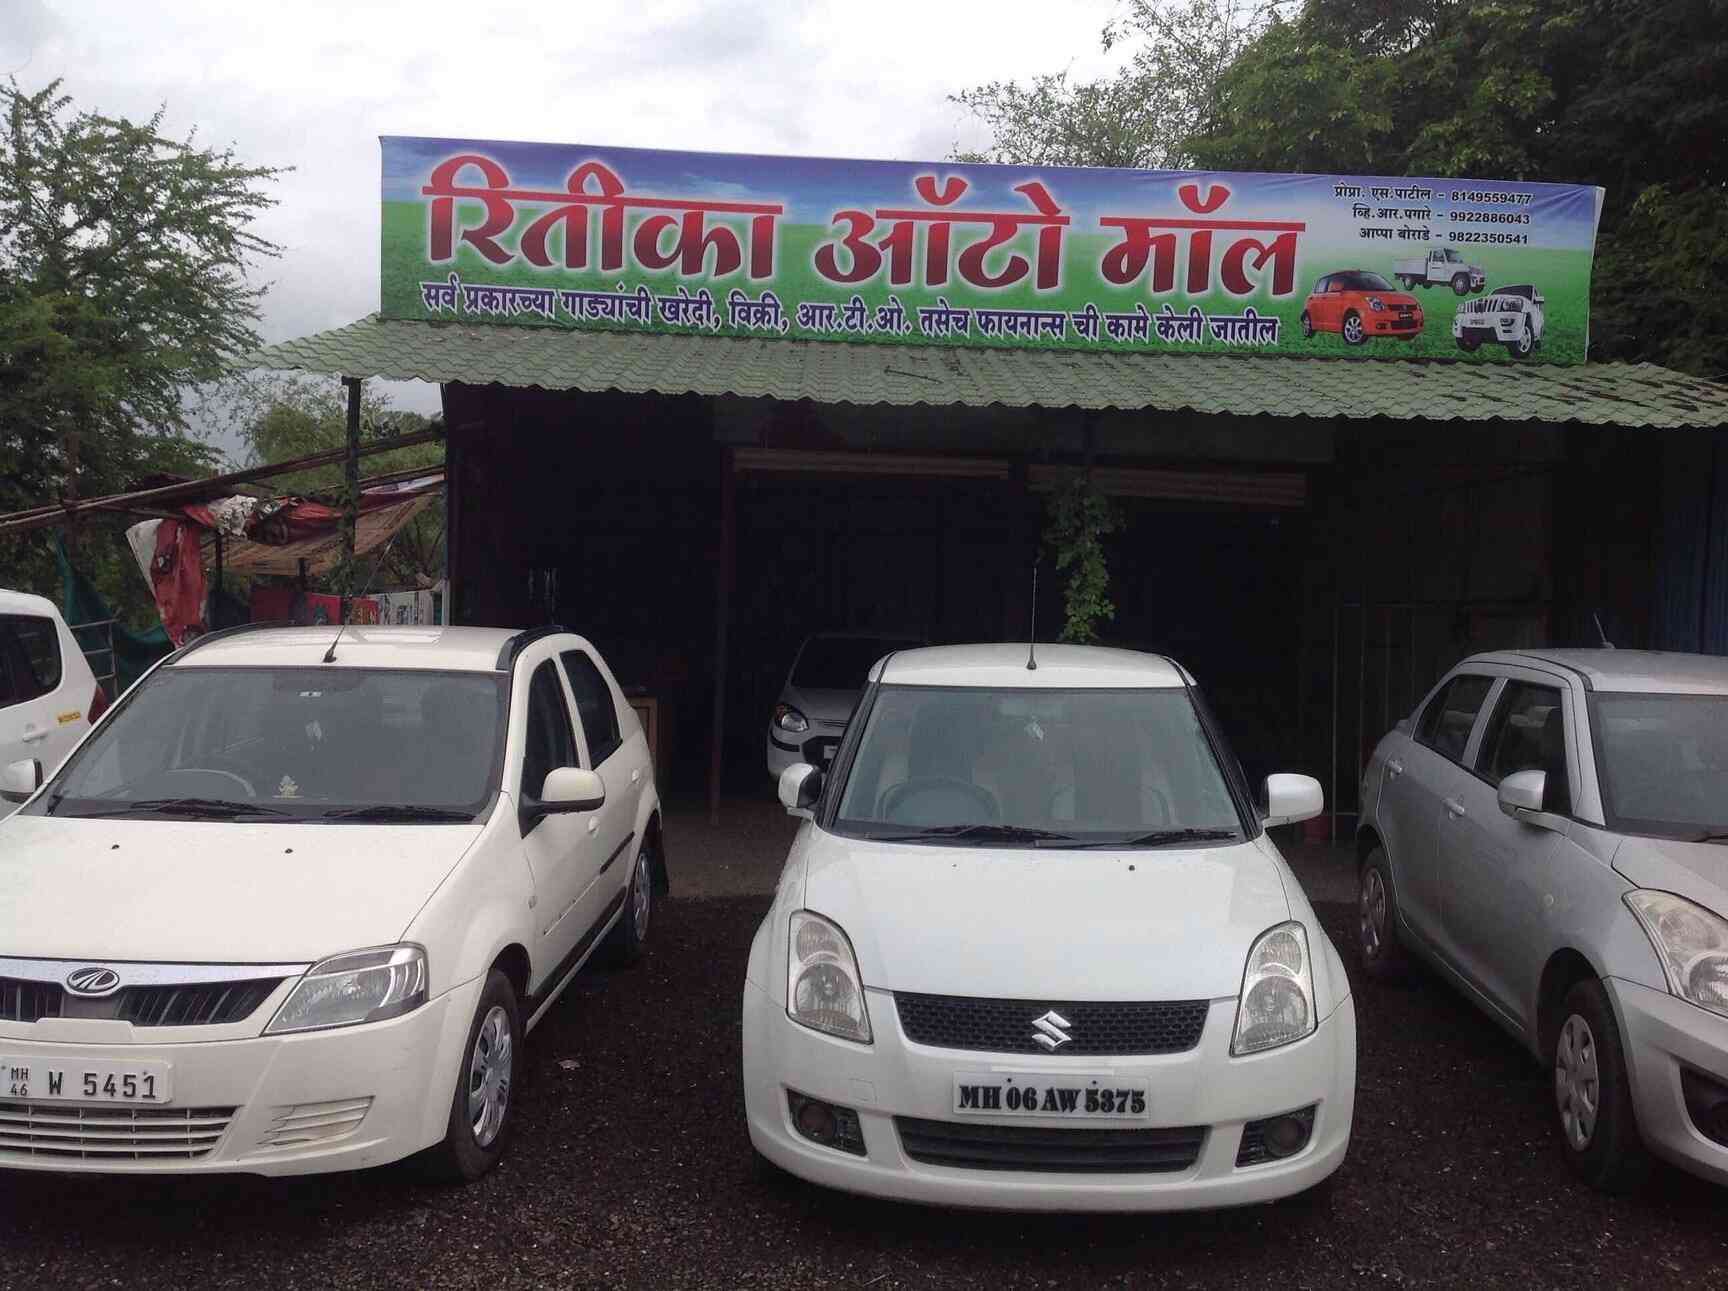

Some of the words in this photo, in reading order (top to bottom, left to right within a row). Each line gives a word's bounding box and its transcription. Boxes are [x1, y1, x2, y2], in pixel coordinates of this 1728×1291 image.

[1451, 191, 1532, 205] 8149559477
[1450, 211, 1530, 225] 9922886043
[422, 154, 784, 280] रितीका
[814, 175, 1071, 291] ऑटो
[1100, 184, 1306, 297] मॉल
[1448, 231, 1528, 245] 9822350541
[421, 273, 460, 313] सर्व
[461, 284, 556, 318] प्रकारच्या
[559, 281, 652, 323] गाड्यांची
[917, 296, 971, 338] तसेच
[975, 308, 1067, 342] फायनान्स
[1070, 302, 1100, 342] ची
[1103, 302, 1150, 343] कामे
[1153, 303, 1204, 344] केली
[1208, 305, 1279, 345] जातील
[11, 1067, 29, 1080] MH
[10, 1083, 28, 1096] 46
[49, 1071, 63, 1095] W
[84, 1073, 156, 1098] 5451
